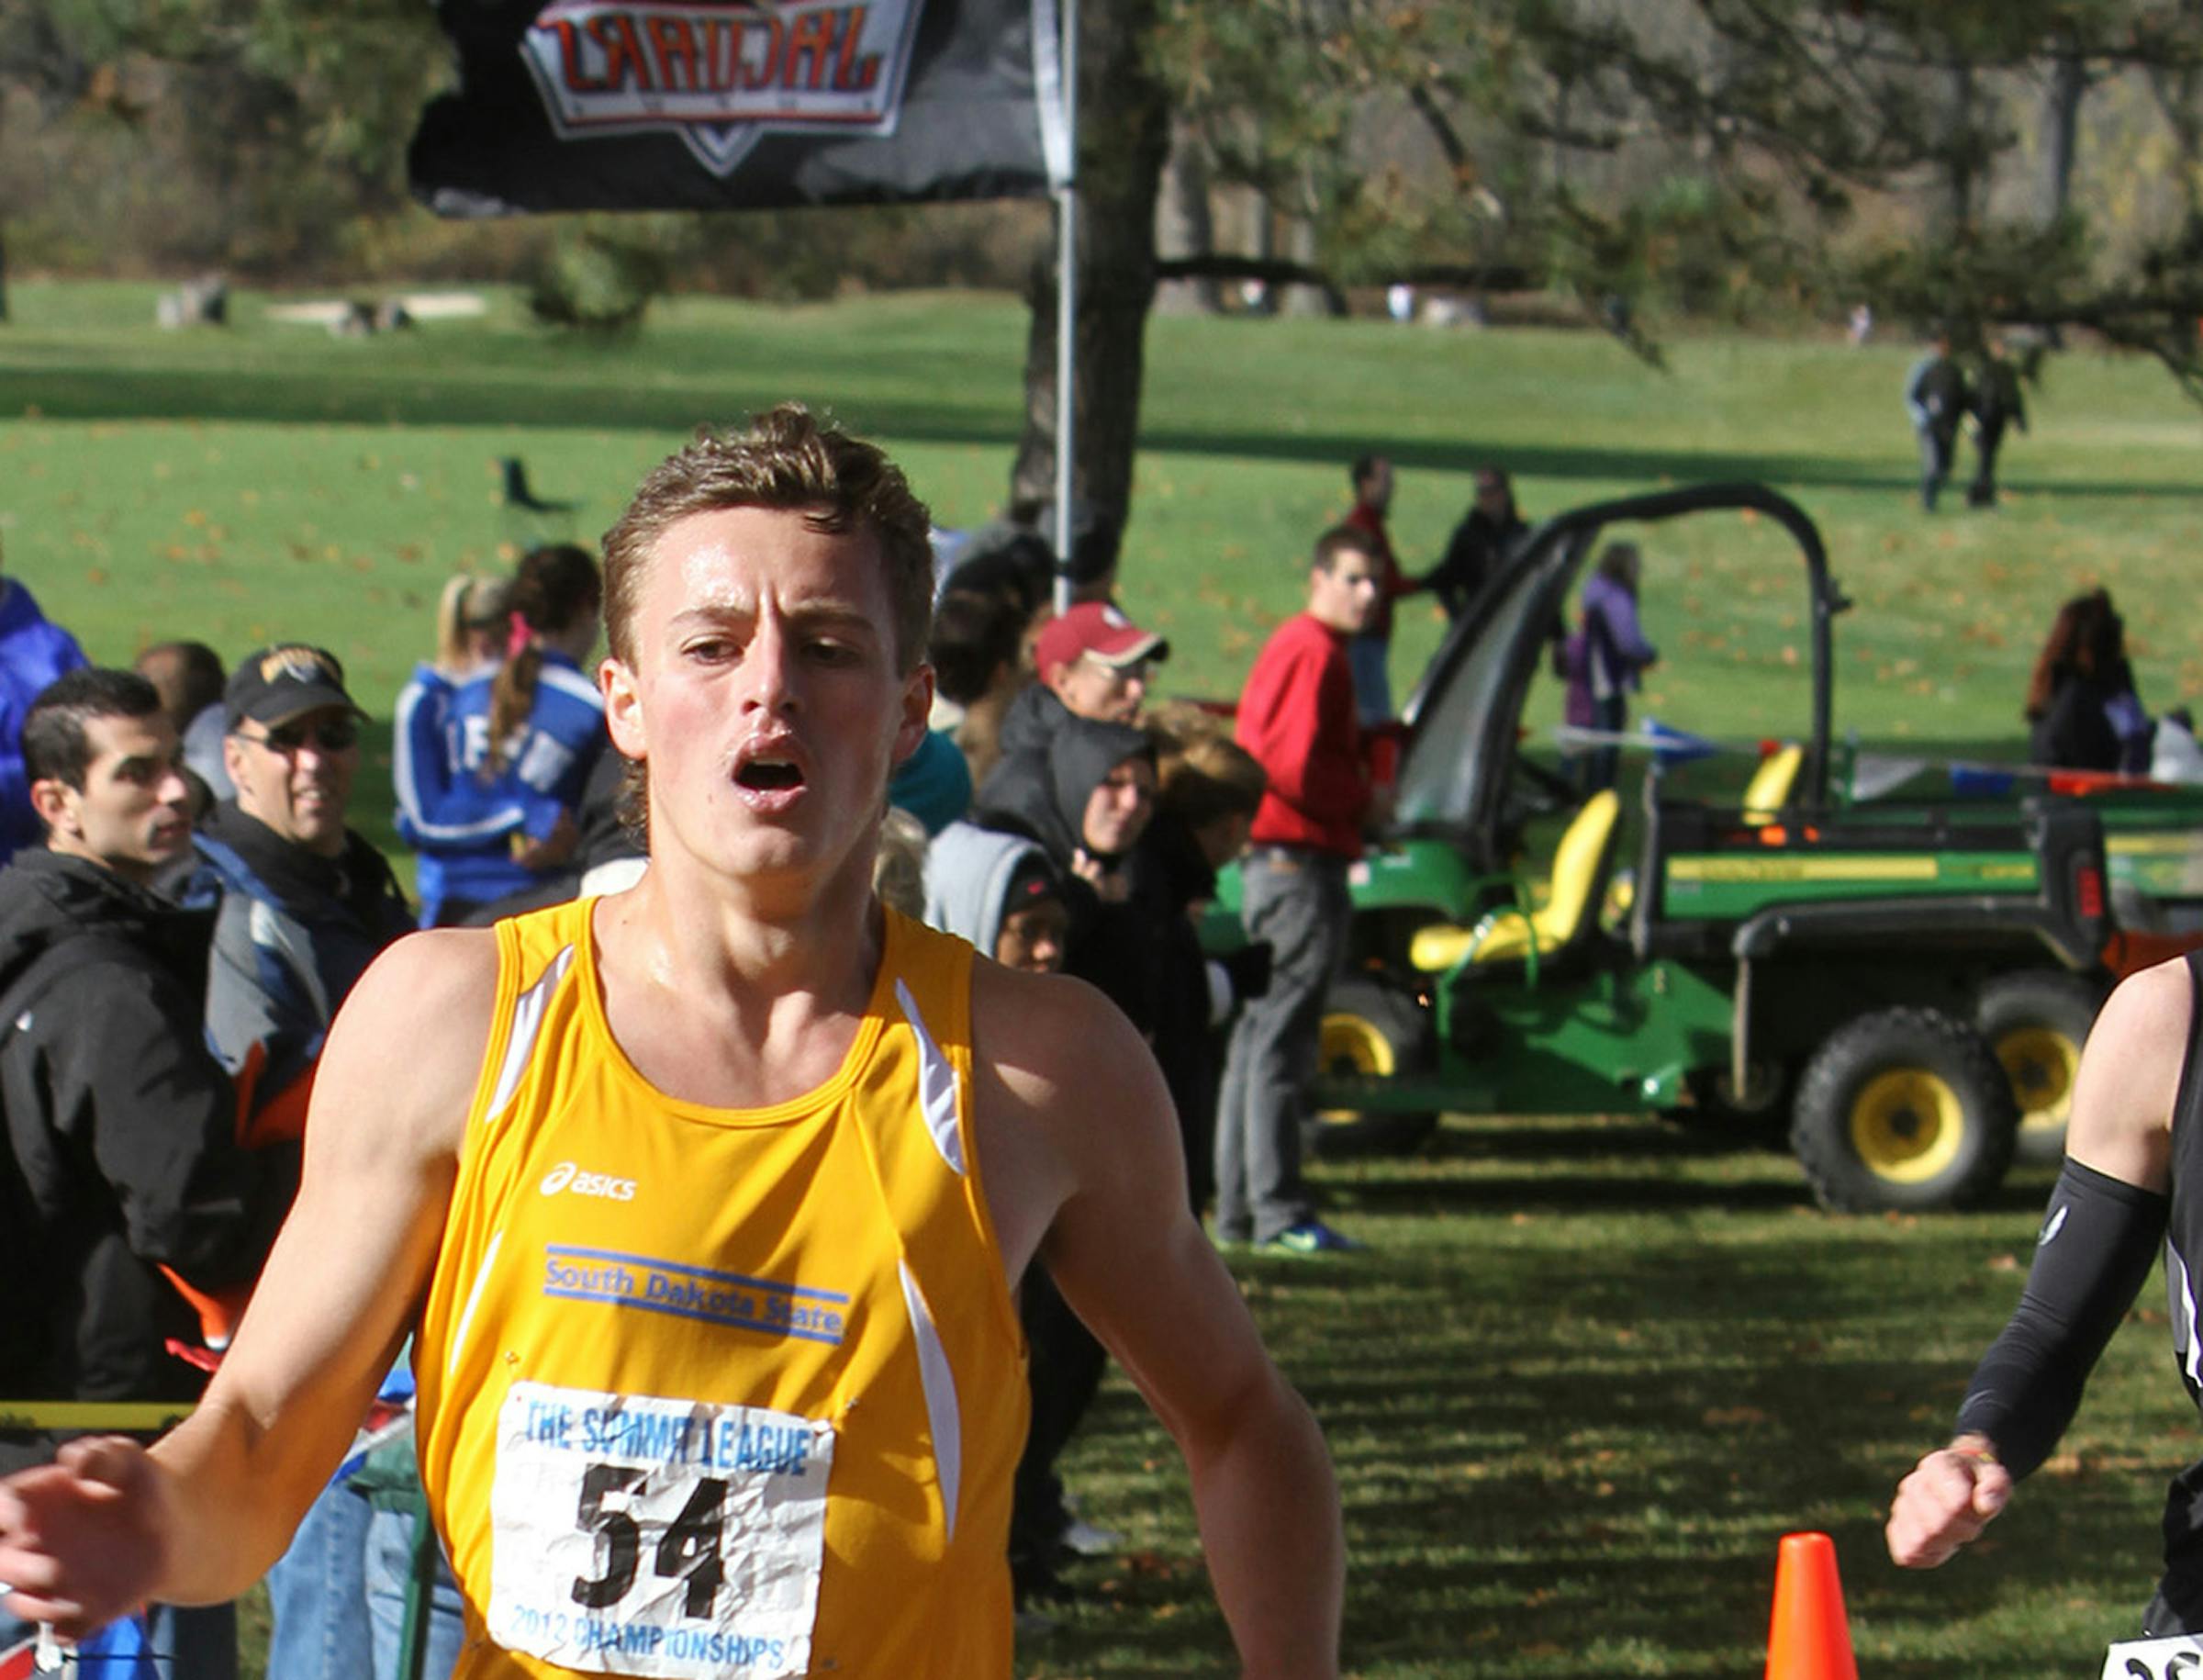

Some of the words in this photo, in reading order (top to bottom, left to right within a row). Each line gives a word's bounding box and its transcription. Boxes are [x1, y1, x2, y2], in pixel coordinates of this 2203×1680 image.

[571, 1170, 637, 1200] asics
[545, 1259, 634, 1294] South
[645, 1272, 756, 1316] Dakota
[764, 1292, 844, 1332] State
[525, 1400, 573, 1449] THE
[701, 1419, 811, 1475] LEAGUE
[570, 1462, 729, 1619] 54
[510, 1604, 565, 1643] 2012
[574, 1620, 785, 1670] CHAMPIONSHIPS
